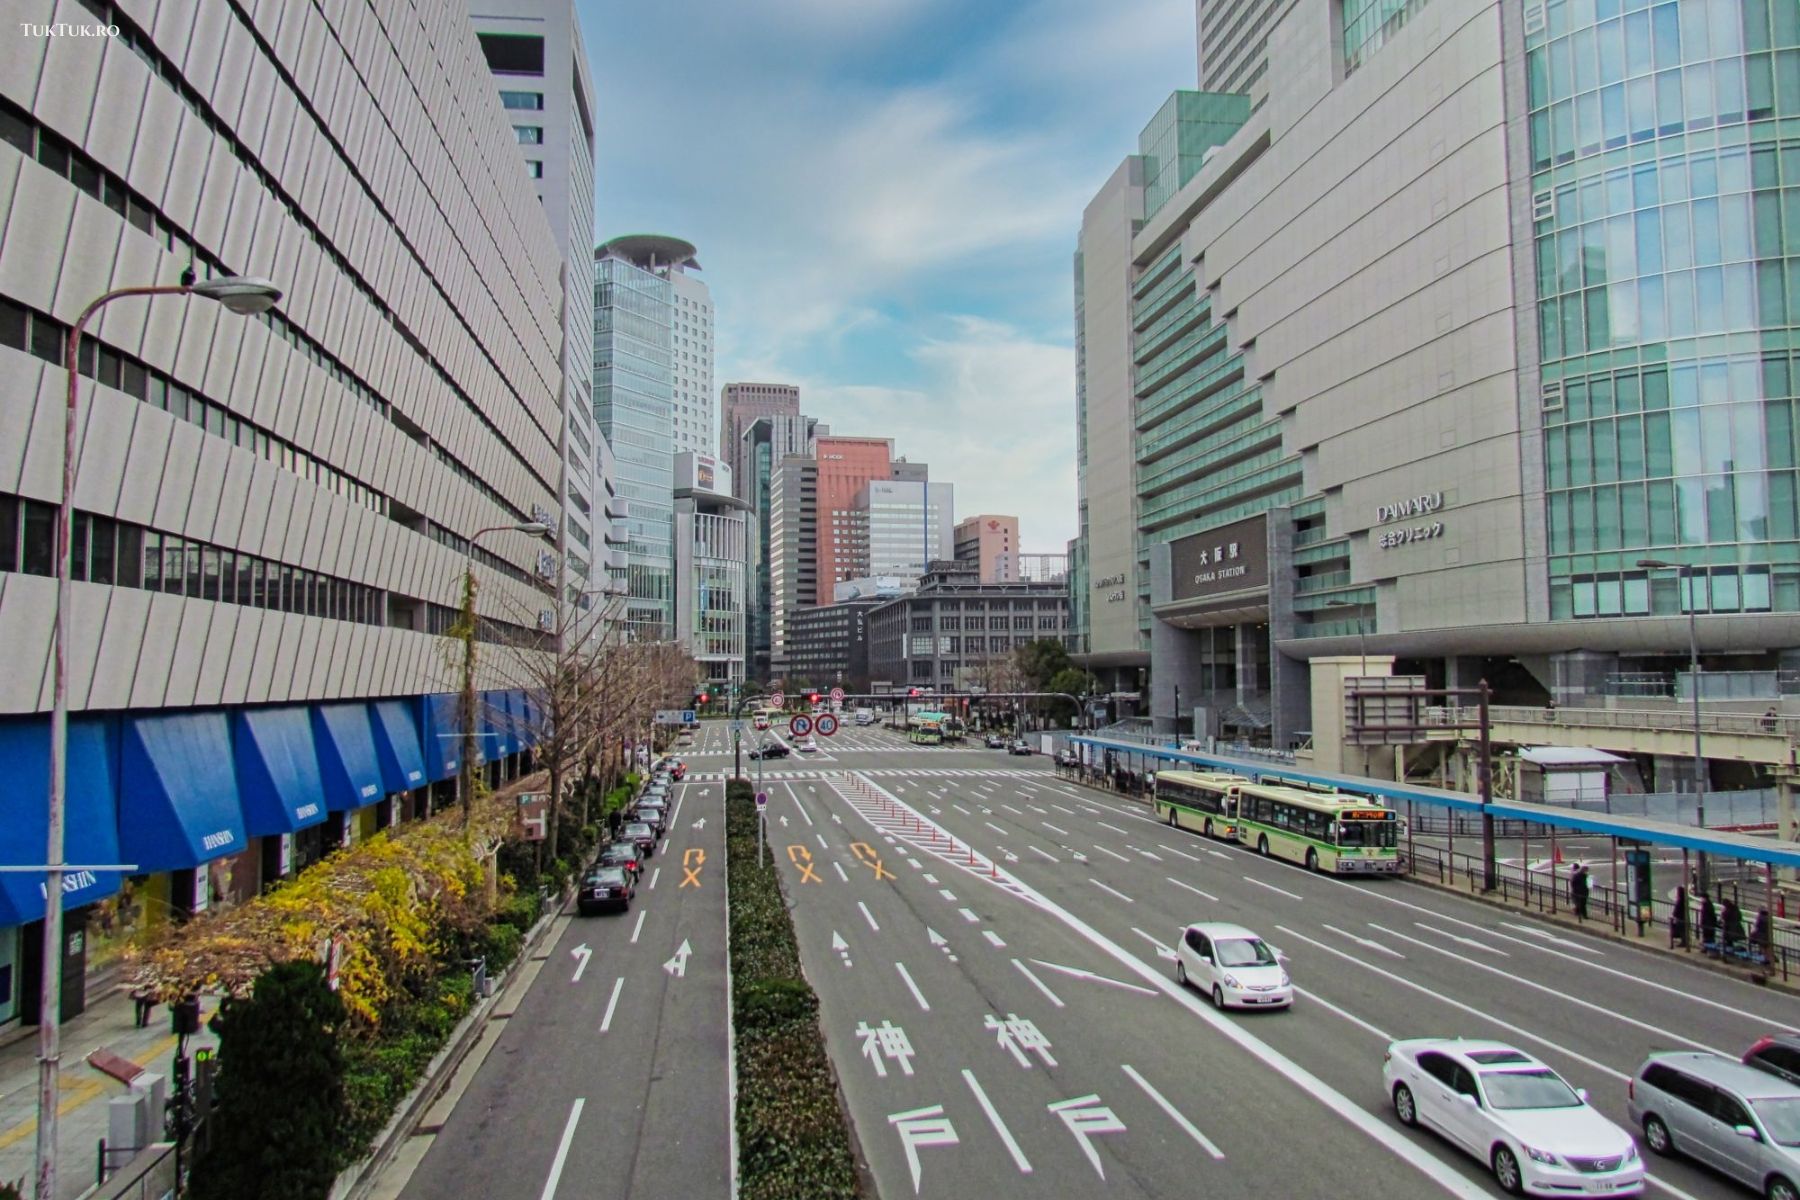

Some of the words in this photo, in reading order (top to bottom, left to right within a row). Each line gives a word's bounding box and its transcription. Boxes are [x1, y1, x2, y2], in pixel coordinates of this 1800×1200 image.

[1376, 491, 1443, 522] DAIMARU
[1194, 571, 1216, 584] OSAKA
[1217, 565, 1245, 579] STATION
[820, 719, 833, 731] 40
